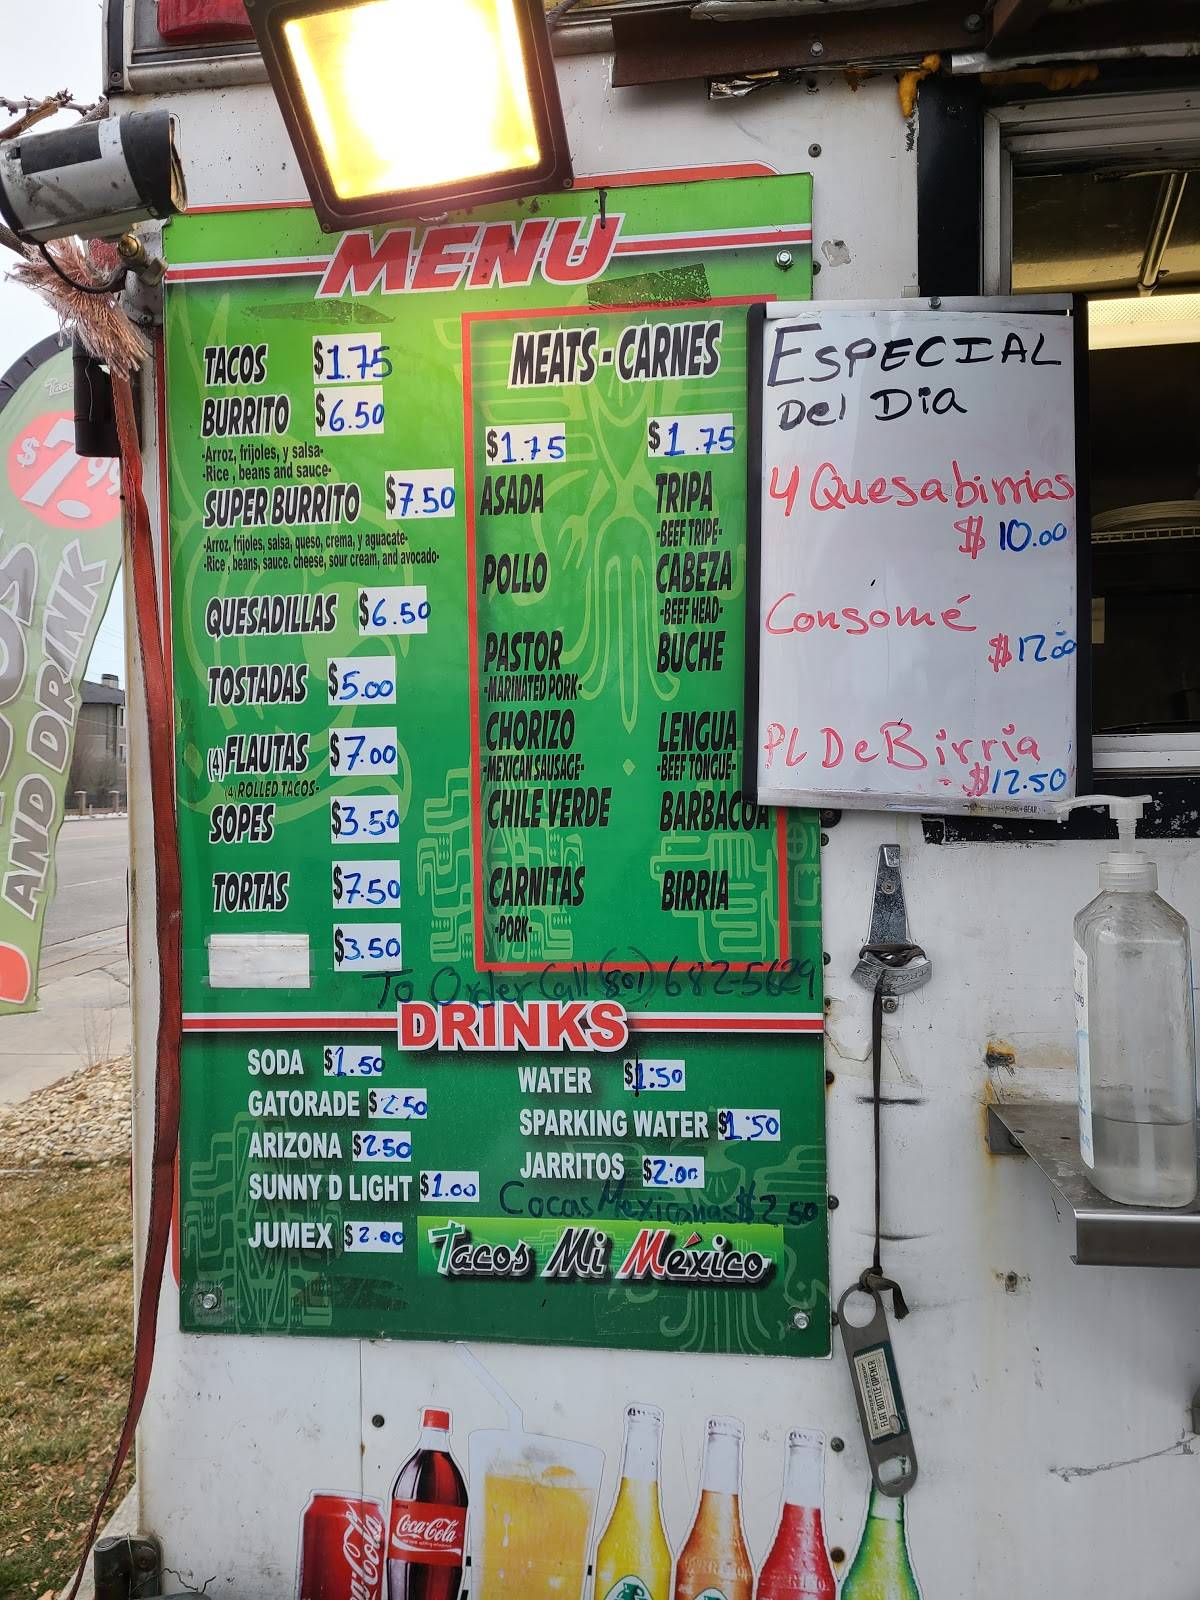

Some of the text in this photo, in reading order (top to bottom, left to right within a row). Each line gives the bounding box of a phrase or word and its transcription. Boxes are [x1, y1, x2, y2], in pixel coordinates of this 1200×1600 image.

[314, 213, 625, 299] MENU
[204, 344, 267, 386] TACOS
[314, 338, 393, 380] $1.75
[508, 327, 599, 388] MEATS
[615, 321, 723, 383] CARNES
[767, 323, 1062, 387] ESPECIAL
[201, 394, 291, 438] BURRITO
[315, 391, 385, 432] $6.50
[777, 393, 847, 431] Del
[240, 444, 280, 466] frijoles,
[283, 446, 289, 462] y
[486, 429, 566, 463] $1.75
[238, 463, 270, 481] beans
[274, 462, 293, 480] and
[656, 470, 713, 513] TRIPA
[769, 465, 801, 516] 4
[203, 483, 360, 528] SUPER BURRITO
[386, 474, 456, 517] $7.50
[480, 473, 544, 516] ASADA
[232, 554, 261, 574] beans,
[293, 552, 326, 571] cheese,
[328, 555, 348, 568] sour
[350, 552, 380, 570] cream,
[382, 550, 398, 566] and
[233, 534, 265, 555] frijoles,
[267, 533, 293, 552] salsa,
[295, 534, 323, 554] queso,
[325, 534, 355, 551] crema,
[357, 535, 363, 551] y
[482, 552, 548, 594] POLLO
[656, 551, 732, 593] CABEZA
[206, 592, 339, 641] QUESADILLAS
[359, 591, 431, 630] $6.50
[27, 538, 107, 774] DRINK
[484, 630, 564, 672] PASTOR
[657, 631, 726, 673] BUCHE
[208, 663, 309, 706] TOSTADAS
[328, 661, 394, 701] $5.00
[486, 709, 575, 751] CHORIZO
[658, 710, 737, 752] LENGUA
[330, 732, 398, 771] $7.00
[209, 802, 276, 844] SOPES
[331, 800, 399, 839] $3.50
[487, 787, 612, 829] CHILE VERDE
[659, 790, 770, 832] BARBACOA
[1, 773, 55, 921] AND
[213, 871, 290, 913] TORTAS
[333, 864, 401, 905] $7.50
[489, 866, 585, 908] CARNITAS
[661, 869, 729, 911] BIRRIA
[334, 927, 401, 966] $3.50
[362, 968, 414, 1009] To
[431, 966, 533, 1008] Order
[540, 962, 588, 1000] Call
[397, 1001, 629, 1053] DRINKS
[248, 1048, 304, 1076] SODA
[324, 1047, 385, 1077] $1.50
[518, 1066, 592, 1094] WATER
[248, 1090, 360, 1117] GATORADE
[519, 1108, 709, 1138] SPARKING WATER
[248, 1132, 342, 1159] ARIZONA
[353, 1133, 412, 1159] $2.50
[520, 1152, 624, 1180] JARRITOS
[249, 1174, 412, 1202] SUNNY D LIGHT
[420, 1172, 477, 1199] $1.00
[248, 1222, 333, 1249] JUMEX
[428, 1220, 771, 1282] Tacos Mi México
[867, 1360, 879, 1386] OPENER
[873, 1387, 885, 1411] BOTTLE
[878, 1412, 888, 1428] FLAT
